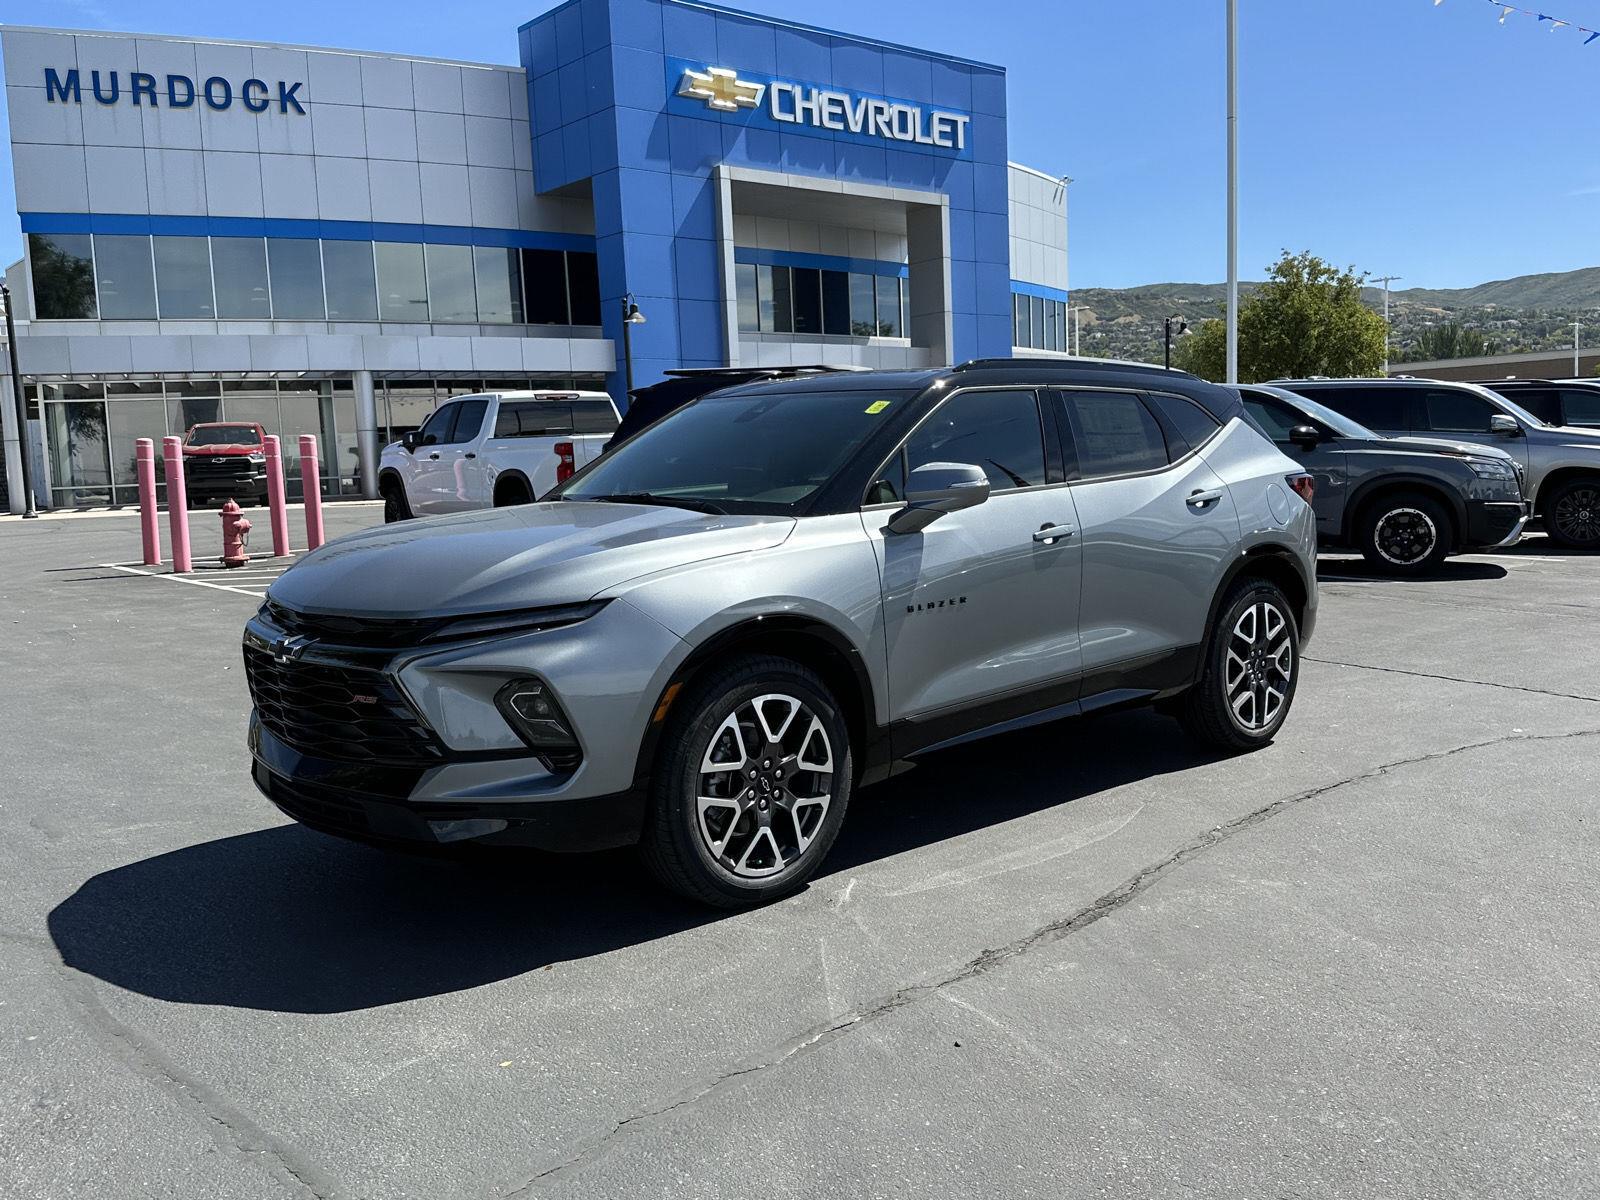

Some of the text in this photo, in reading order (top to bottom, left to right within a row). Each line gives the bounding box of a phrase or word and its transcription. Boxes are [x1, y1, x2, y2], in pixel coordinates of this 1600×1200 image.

[44, 68, 306, 115] MURDOCK
[770, 81, 970, 149] CHEVROLET
[906, 596, 967, 613] BLAZER
[352, 694, 377, 704] RS
